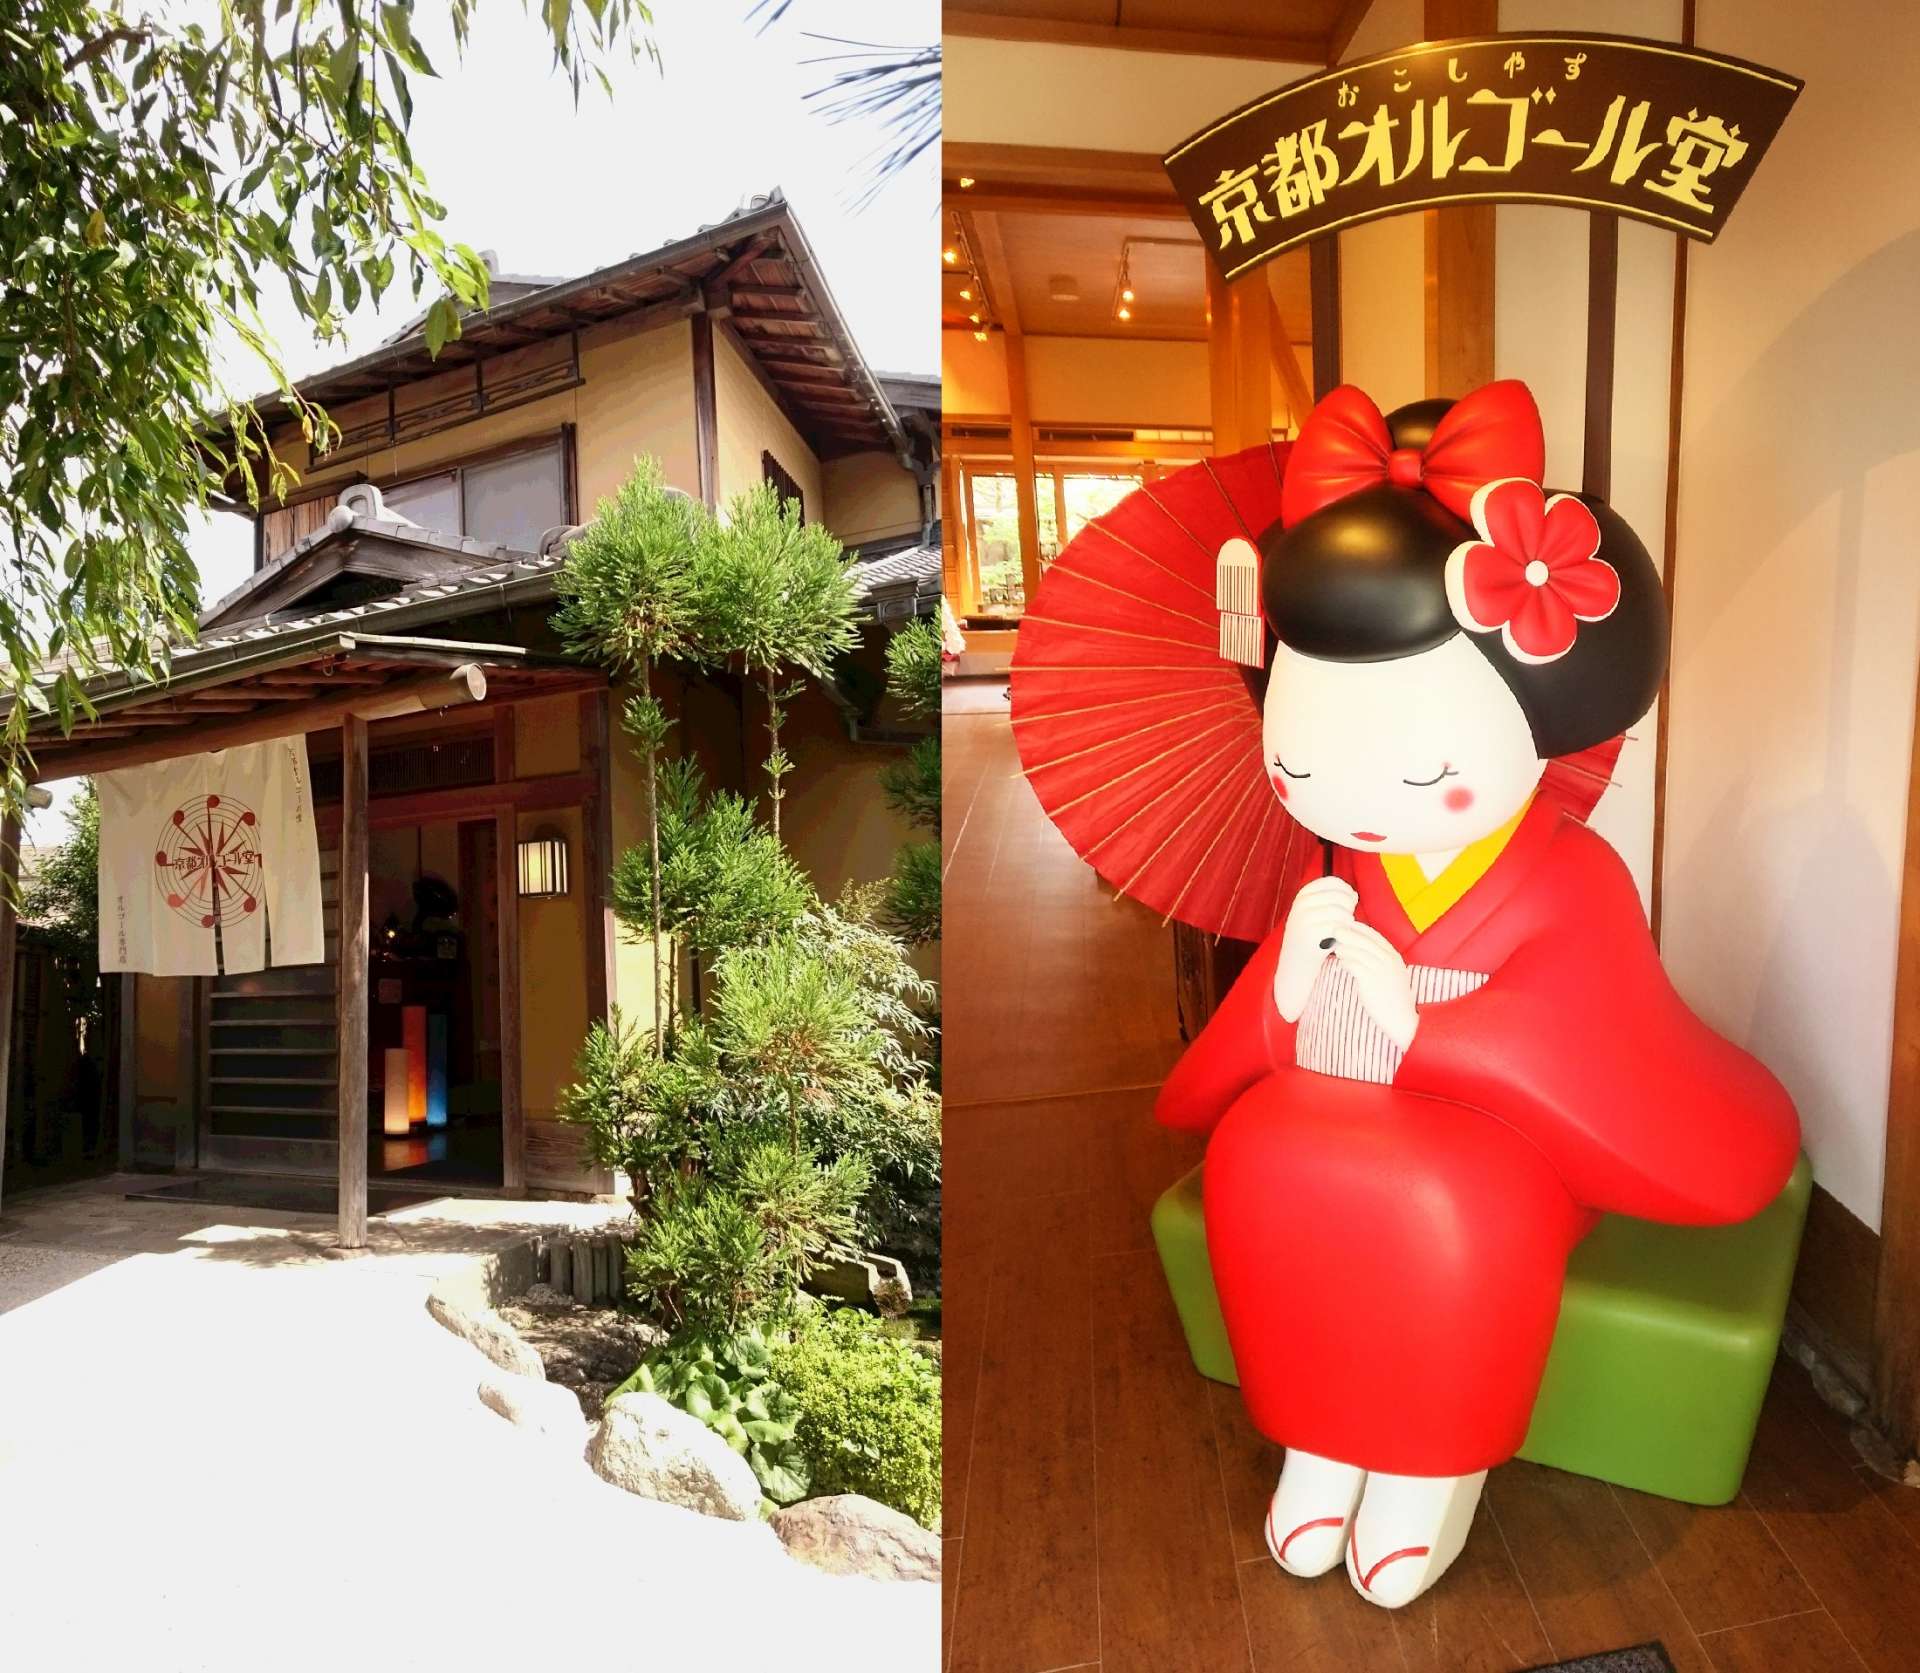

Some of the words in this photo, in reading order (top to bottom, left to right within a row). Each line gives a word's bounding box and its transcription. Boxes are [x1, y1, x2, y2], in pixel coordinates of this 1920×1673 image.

[1338, 52, 1587, 107] おこしやす
[1199, 88, 1748, 249] 京都オルゴール堂
